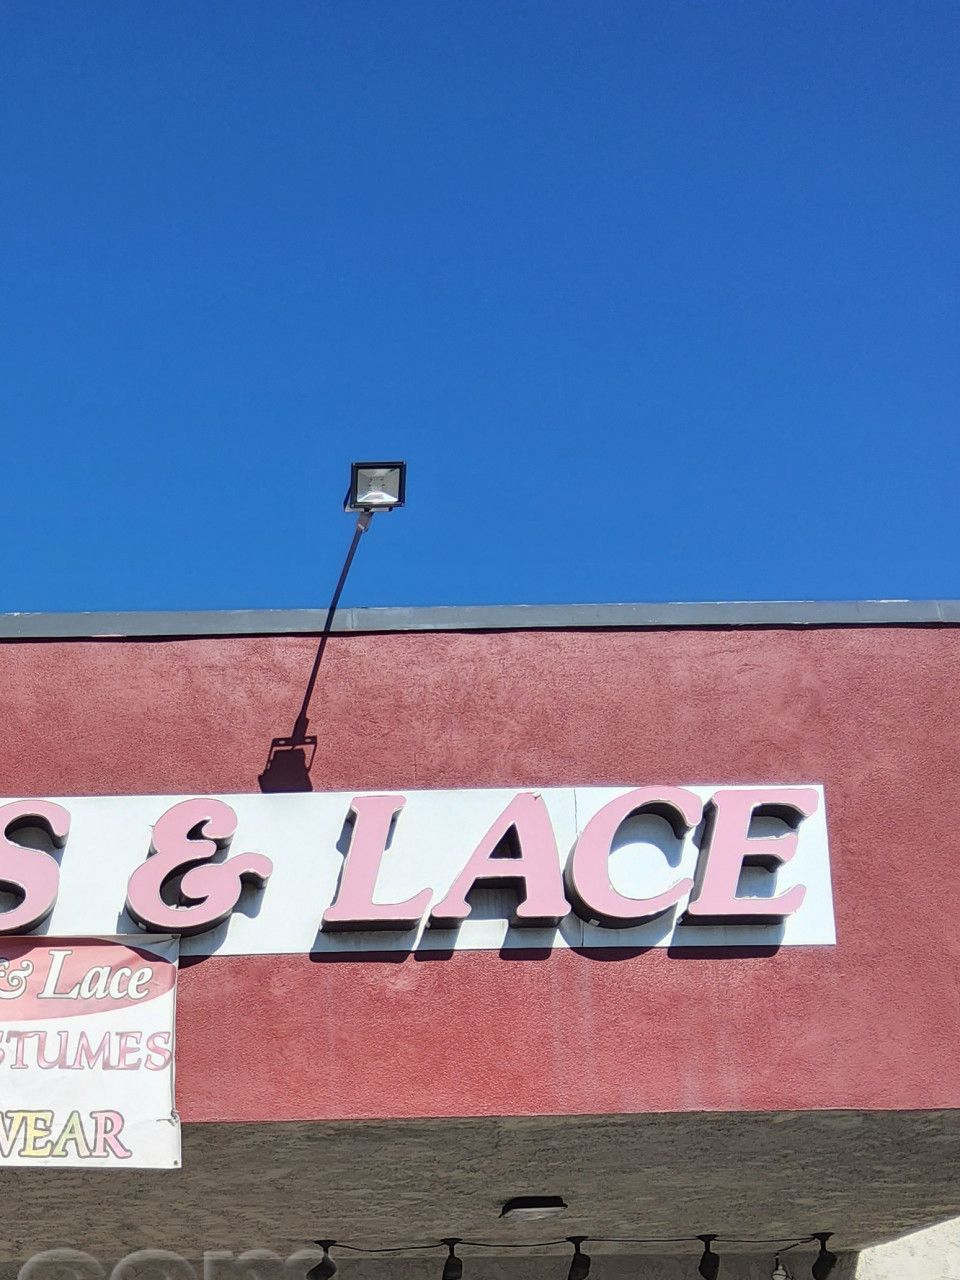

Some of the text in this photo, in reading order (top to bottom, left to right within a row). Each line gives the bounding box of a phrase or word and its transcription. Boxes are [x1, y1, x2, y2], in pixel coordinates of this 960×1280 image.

[126, 797, 273, 933] &
[322, 786, 819, 931] LACE
[38, 949, 153, 1000] Lace
